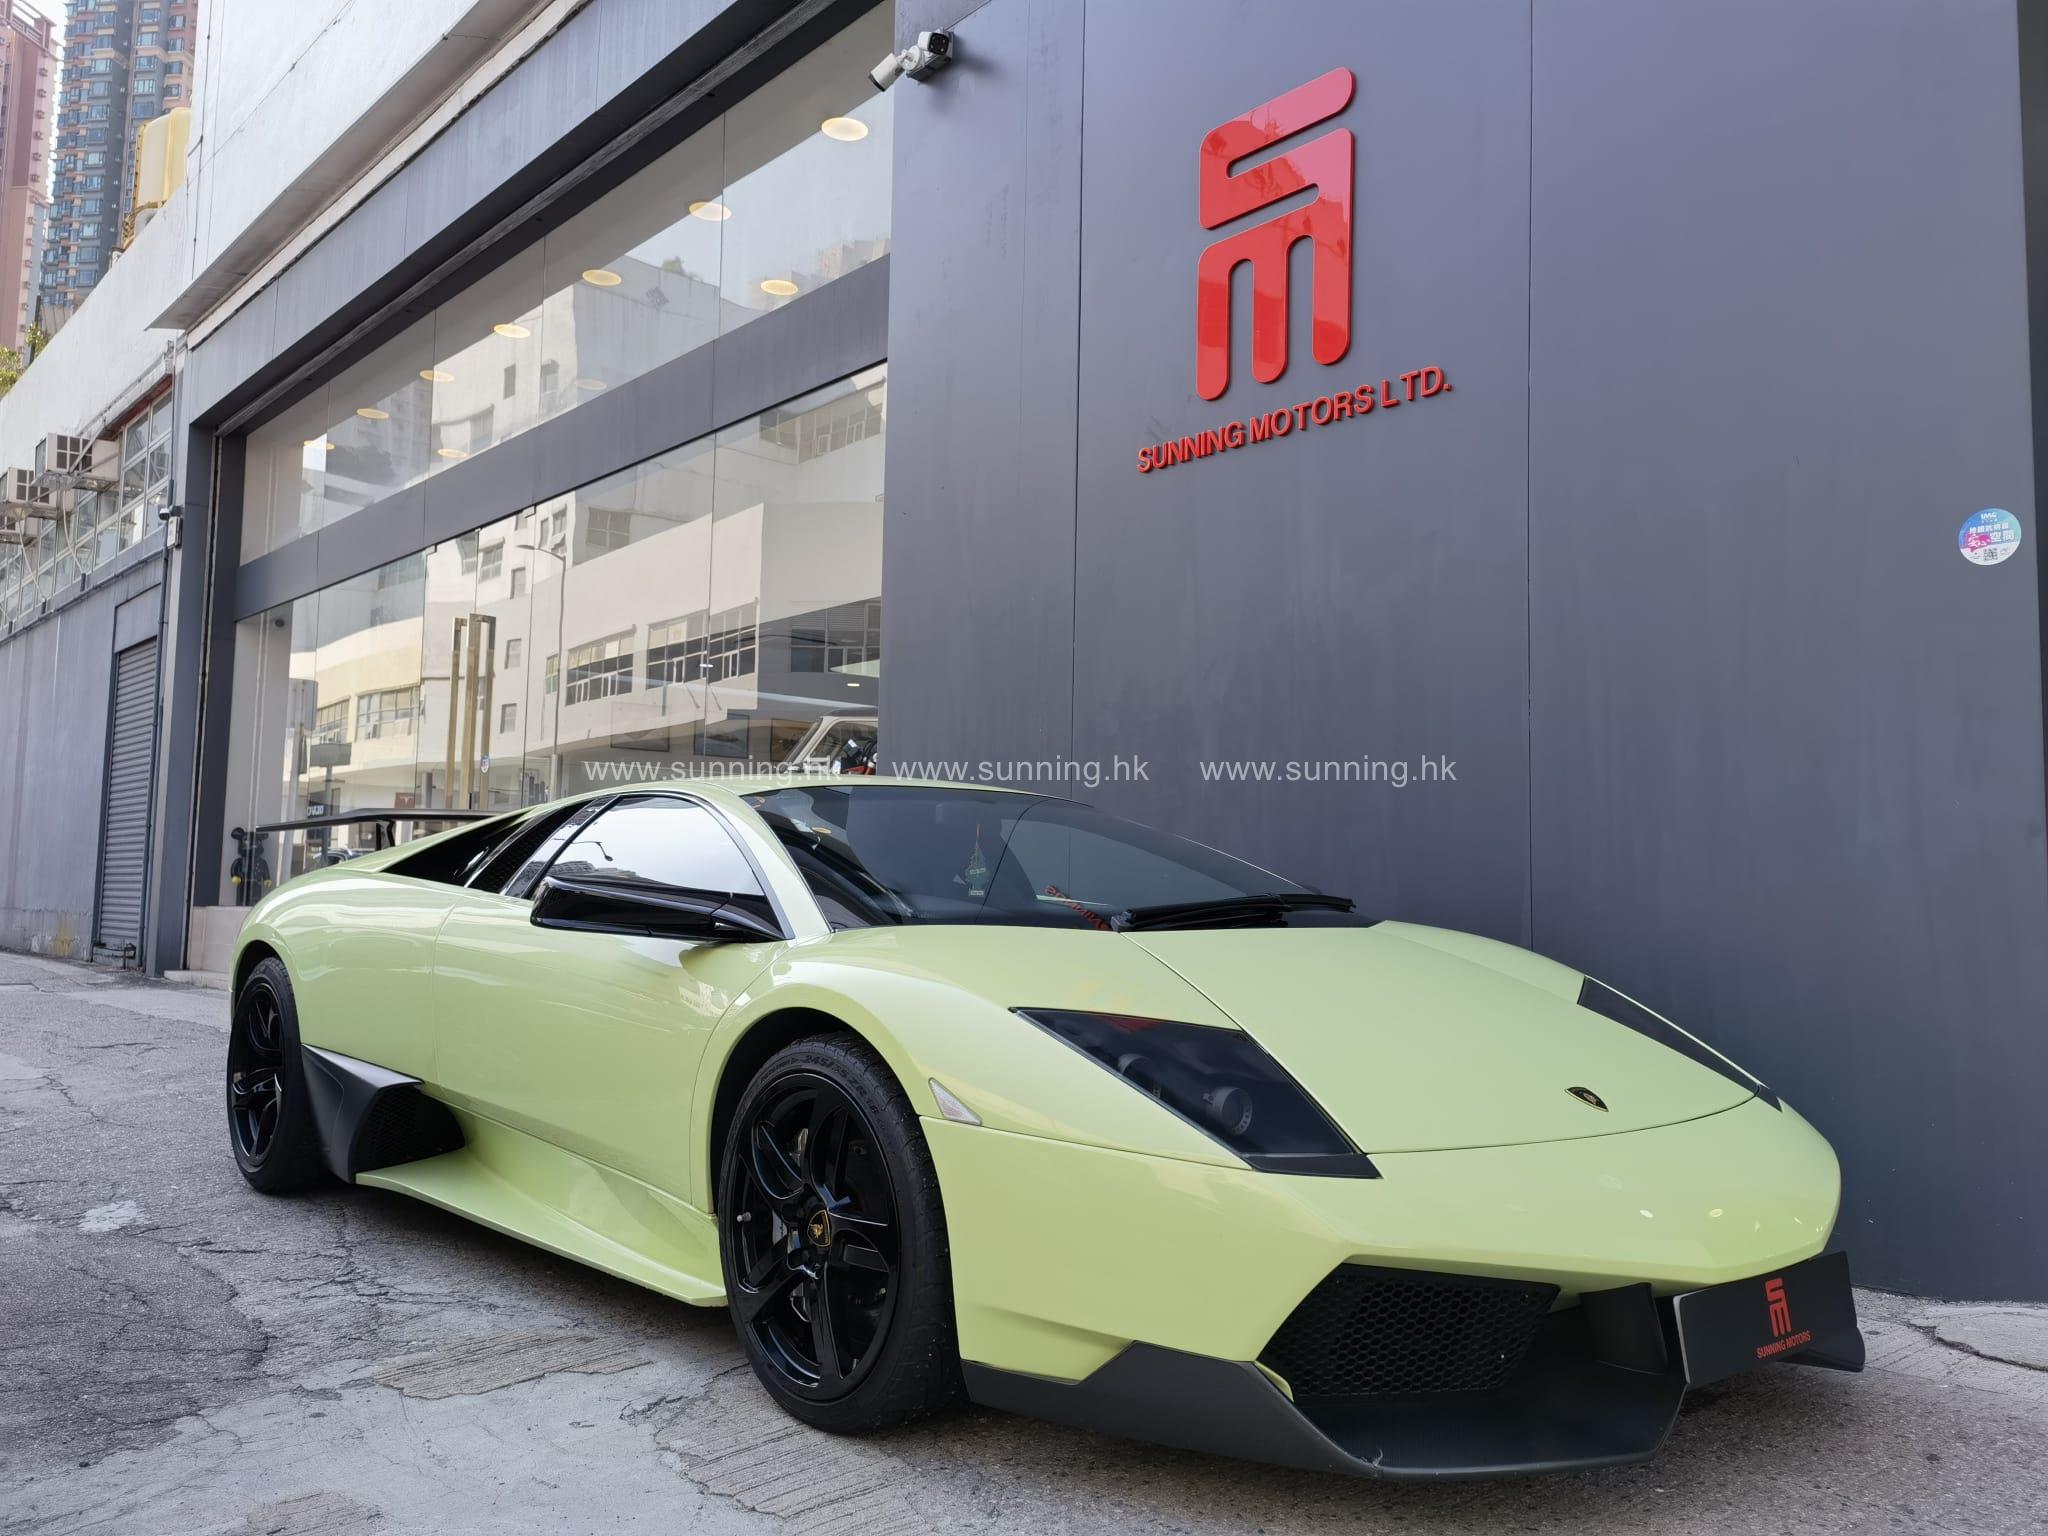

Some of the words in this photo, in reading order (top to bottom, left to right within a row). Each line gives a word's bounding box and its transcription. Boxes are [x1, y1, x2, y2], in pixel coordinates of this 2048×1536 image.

[1137, 421, 1247, 474] SUNNING
[1249, 384, 1375, 443] MOTORS
[1380, 366, 1453, 408] LTD.
[1757, 1340, 1786, 1359] SUNNING
[1786, 1331, 1811, 1349] MOTORS
